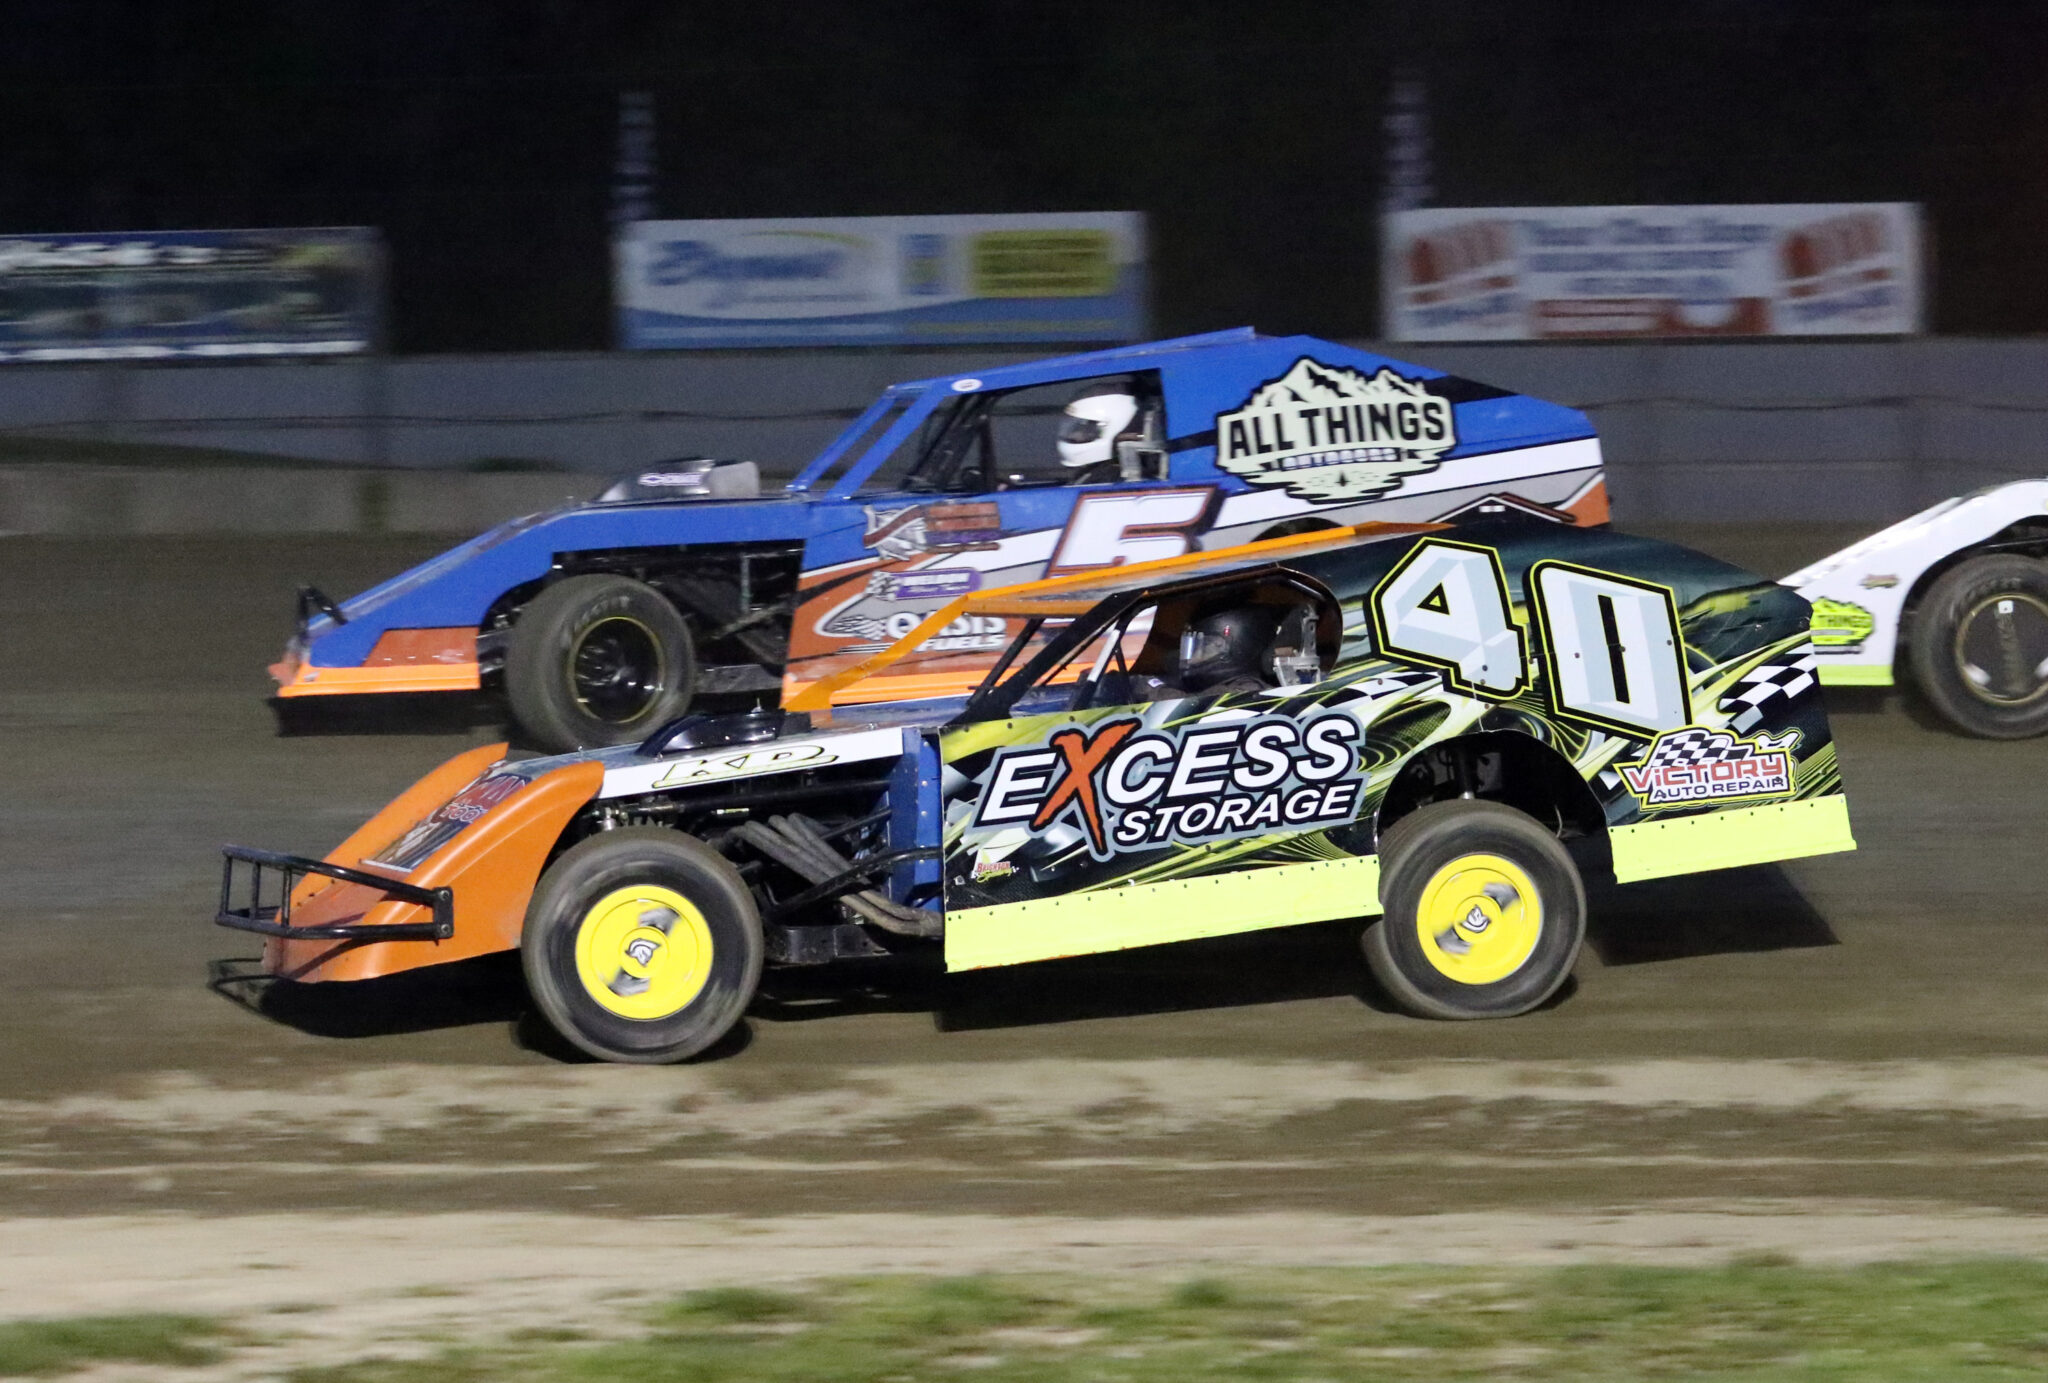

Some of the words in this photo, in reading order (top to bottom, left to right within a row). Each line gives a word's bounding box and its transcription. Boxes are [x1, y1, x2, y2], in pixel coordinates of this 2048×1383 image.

[1229, 413, 1295, 460] ALL
[1299, 402, 1445, 447] THINGS
[1372, 539, 1691, 737] 40
[975, 716, 1360, 853] EXCESS
[1114, 783, 1359, 843] STORAGE
[1653, 785, 1707, 799] AUTO
[1712, 777, 1785, 794] REPAIR
